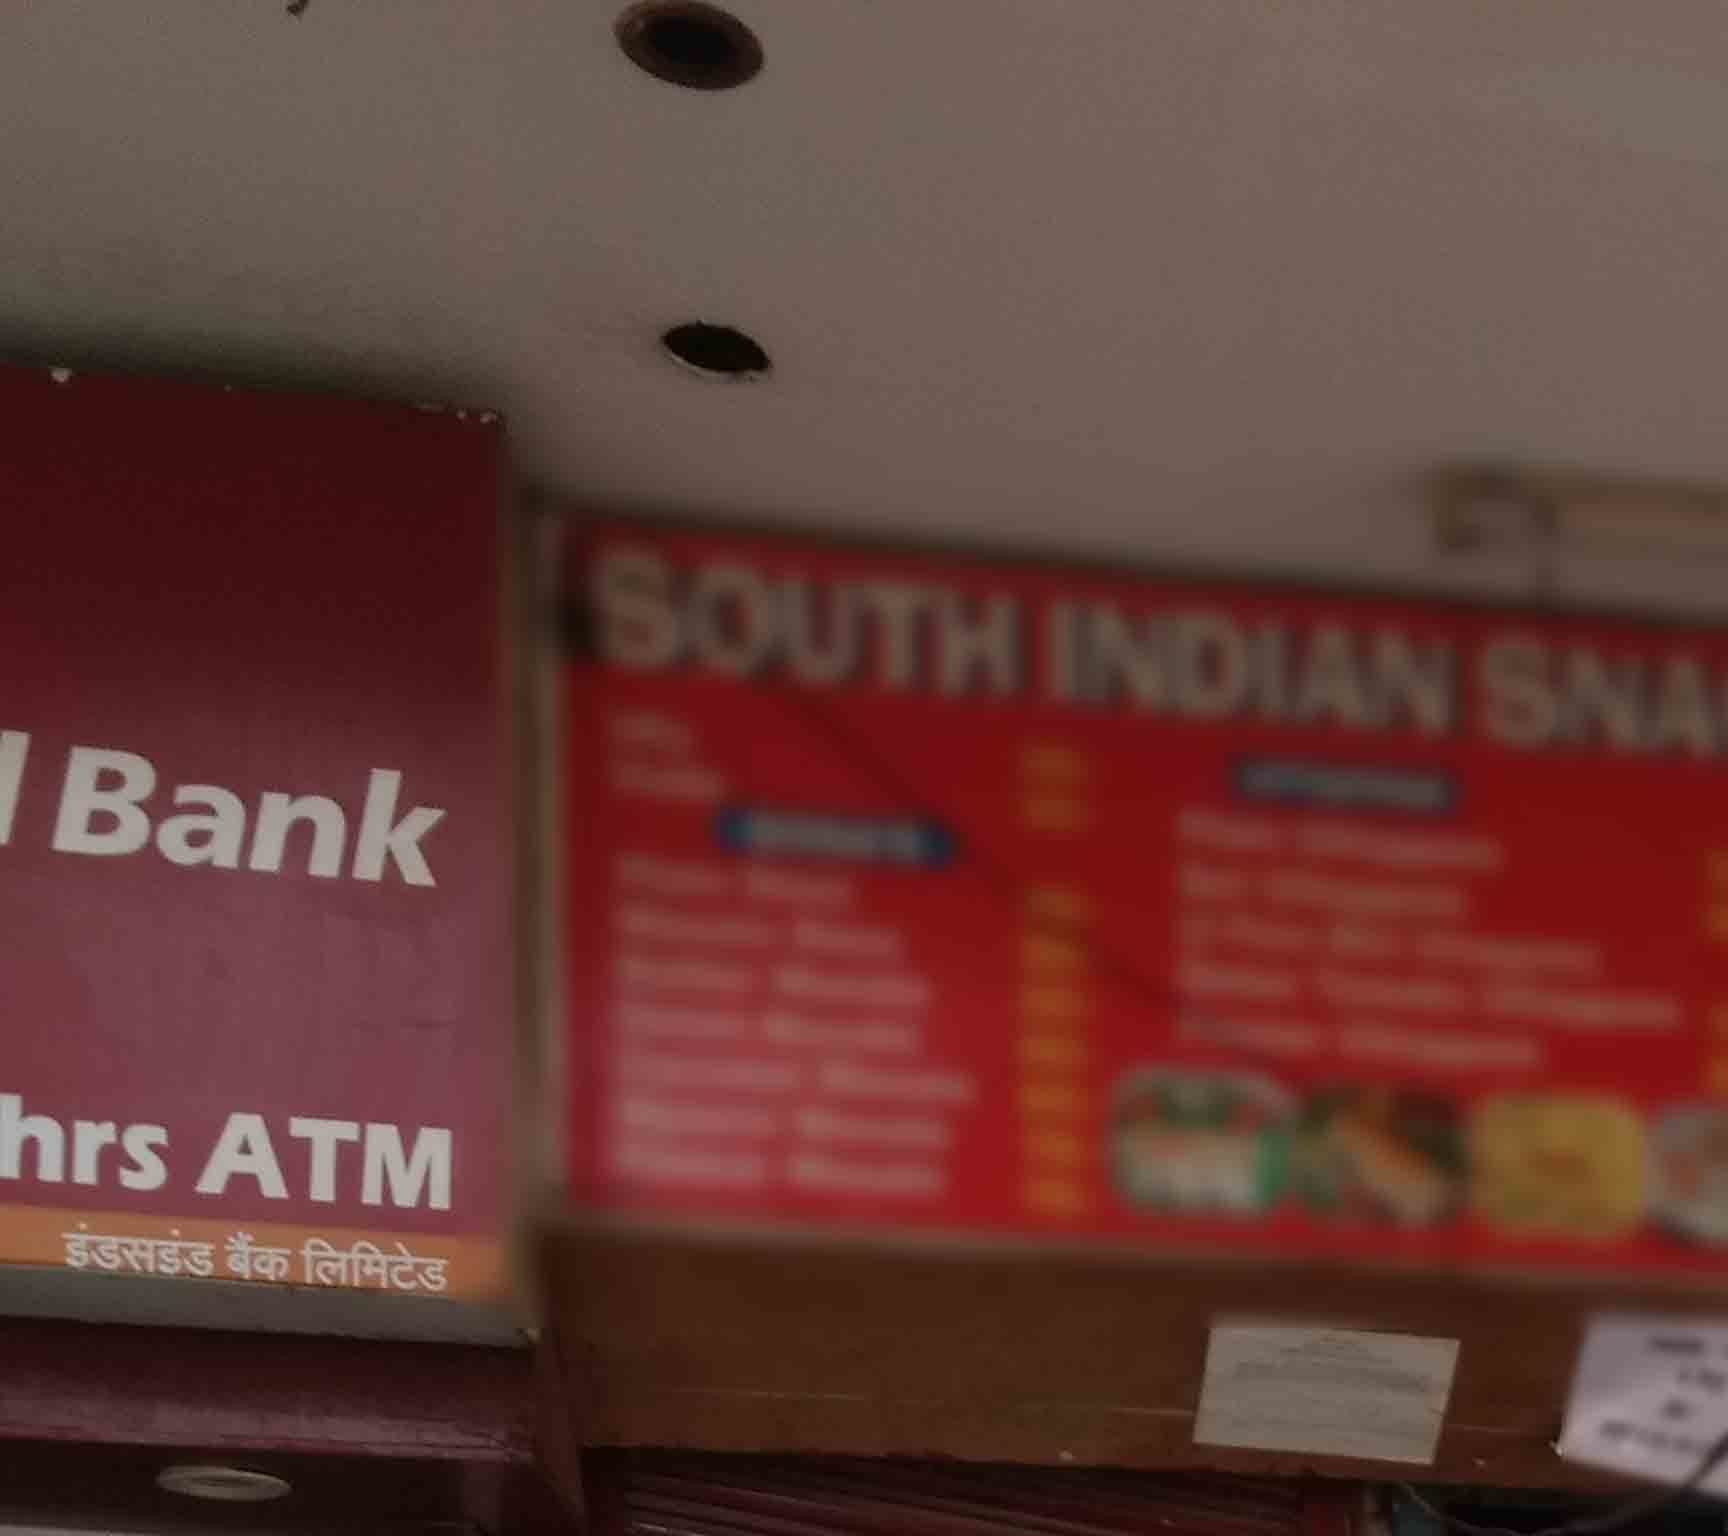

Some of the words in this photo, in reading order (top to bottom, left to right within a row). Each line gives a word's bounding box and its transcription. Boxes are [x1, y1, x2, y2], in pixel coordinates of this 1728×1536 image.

[596, 545, 1018, 697] SOUTH
[1047, 597, 1456, 735] INDIAN
[52, 744, 447, 889] Bank
[194, 1110, 454, 1211] ATM
[302, 1237, 449, 1292] लिमिटेड
